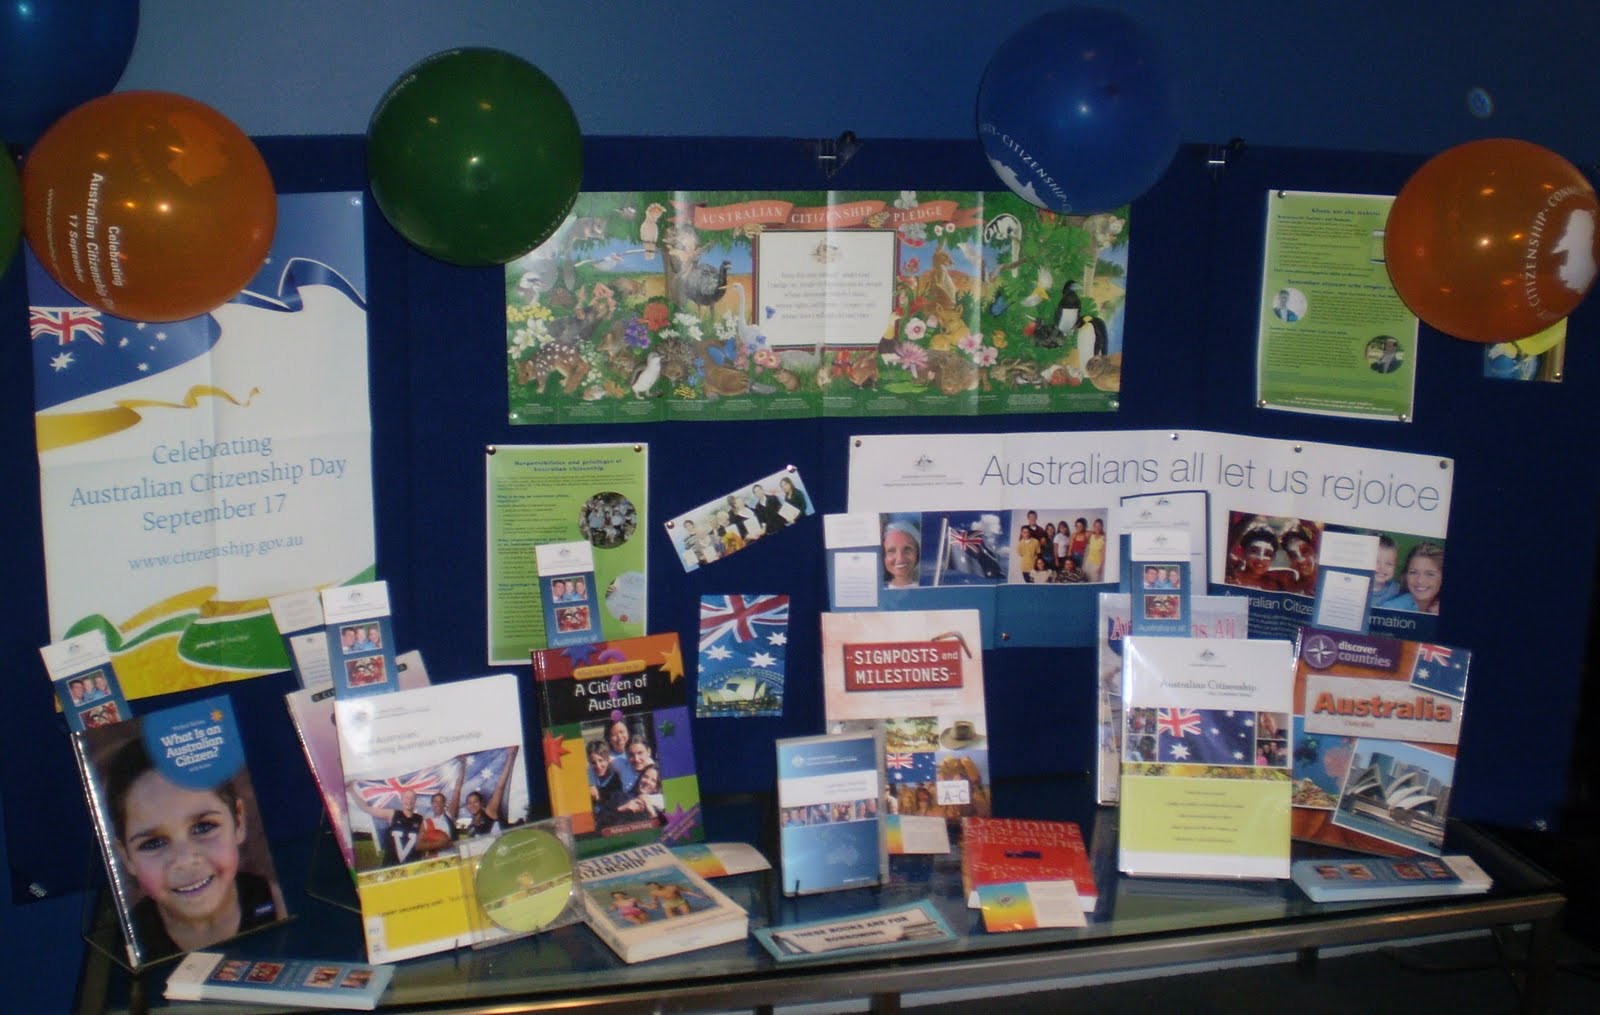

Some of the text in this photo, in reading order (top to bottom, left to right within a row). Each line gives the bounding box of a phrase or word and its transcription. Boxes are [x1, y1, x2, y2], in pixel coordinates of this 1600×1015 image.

[86, 172, 104, 239] Australian
[702, 205, 943, 225] AUSTRALIAN CITIZENSHIP PLEDGE
[69, 214, 84, 283] 17 September
[108, 226, 124, 287] Celebrating
[1525, 210, 1547, 307] CITIZENSHIP
[152, 436, 273, 464] Celebrating
[69, 456, 347, 508] Australian Citizenship Day
[980, 451, 1440, 512] Australians all let us rejoice
[142, 493, 287, 533] September 17
[128, 533, 304, 571] www.citizenship.gov.au
[853, 648, 958, 666] SIGNPOSTS and
[1338, 641, 1377, 655] discover
[1338, 651, 1392, 668] countries
[575, 674, 647, 697] A Citizen of
[856, 667, 950, 685] MILESTONES
[588, 693, 642, 712] Australia
[1313, 691, 1452, 722] Australia
[160, 732, 193, 747] What
[206, 725, 222, 736] an
[166, 736, 224, 758] Australian
[175, 746, 219, 767] Citizen?
